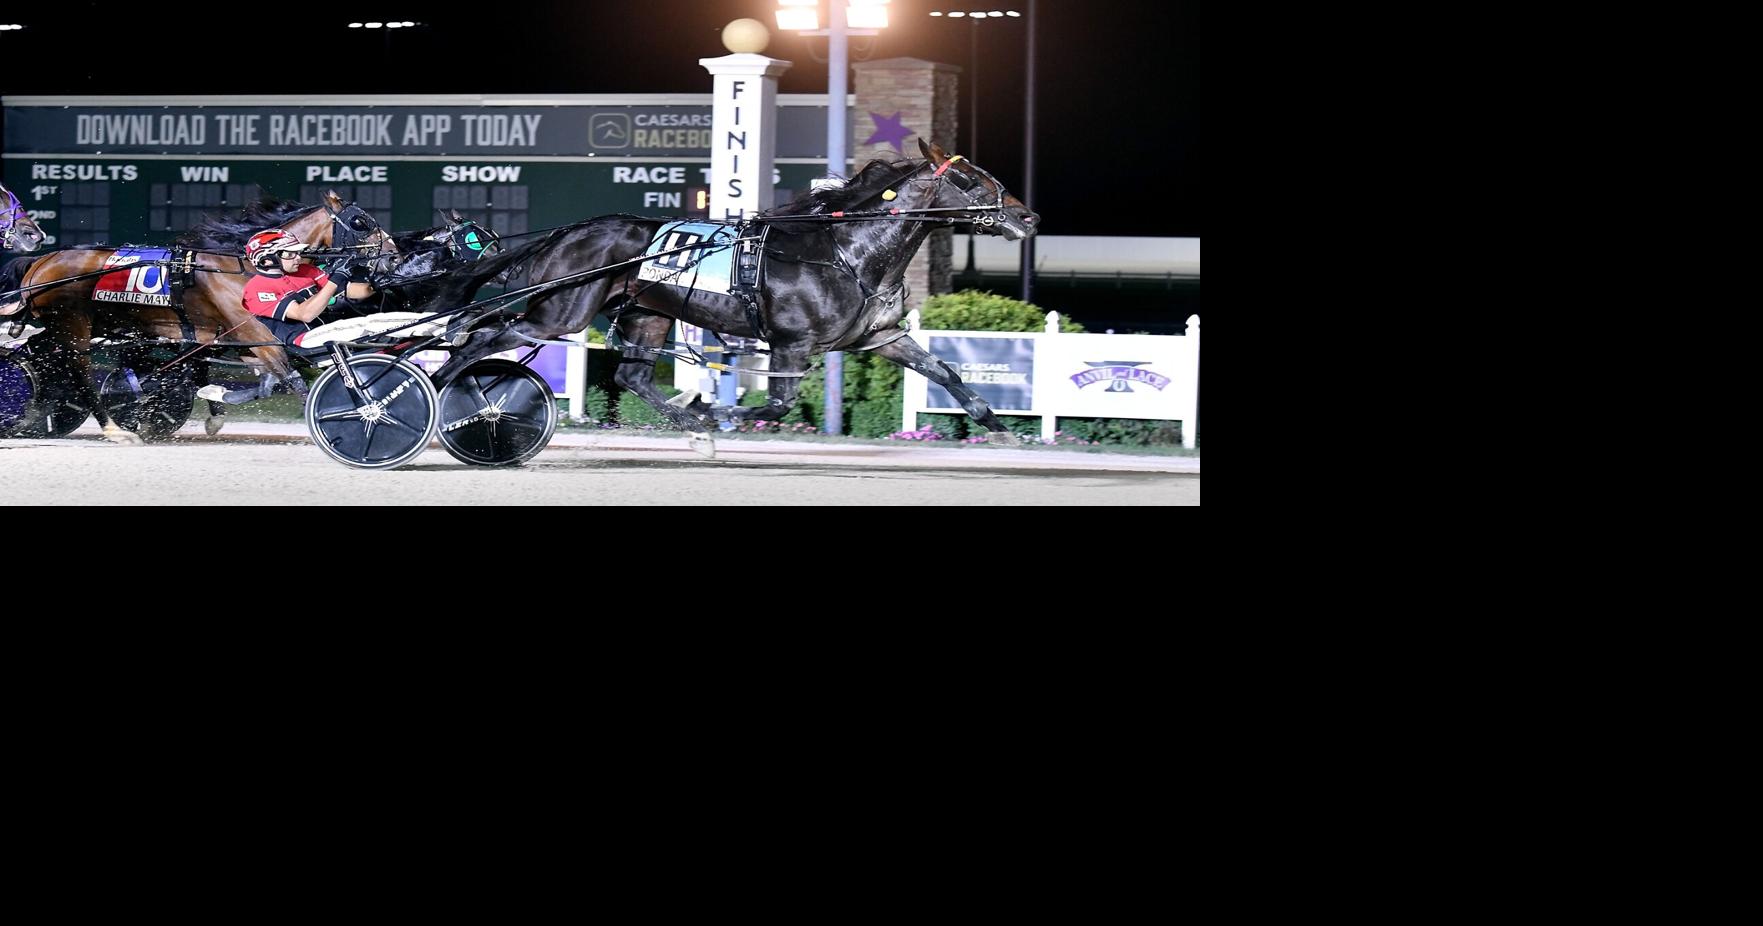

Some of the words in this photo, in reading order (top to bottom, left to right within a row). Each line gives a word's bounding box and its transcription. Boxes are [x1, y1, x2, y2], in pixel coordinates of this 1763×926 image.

[634, 114, 713, 127] CAESARS
[76, 114, 206, 145] DOWNLOAD
[215, 114, 260, 145] THE
[269, 114, 393, 146] RACEBOOK
[401, 114, 451, 146] APP
[460, 114, 542, 146] TODAY
[634, 129, 713, 149] RACEBO
[32, 164, 138, 181] RESULTS
[181, 166, 230, 183] WIN
[306, 165, 389, 182] PLACE
[441, 165, 521, 182] SHOW
[613, 166, 686, 184] RACE
[31, 185, 58, 201] 1ST
[643, 191, 681, 208] FIN
[125, 265, 168, 294] 10
[96, 290, 142, 303] CHARLIE
[143, 294, 170, 306] MAY
[960, 362, 1011, 372] CAESARS
[961, 371, 1028, 385] RACEBOOK
[1077, 367, 1113, 387] ANVIL
[1129, 367, 1166, 388] LACE
